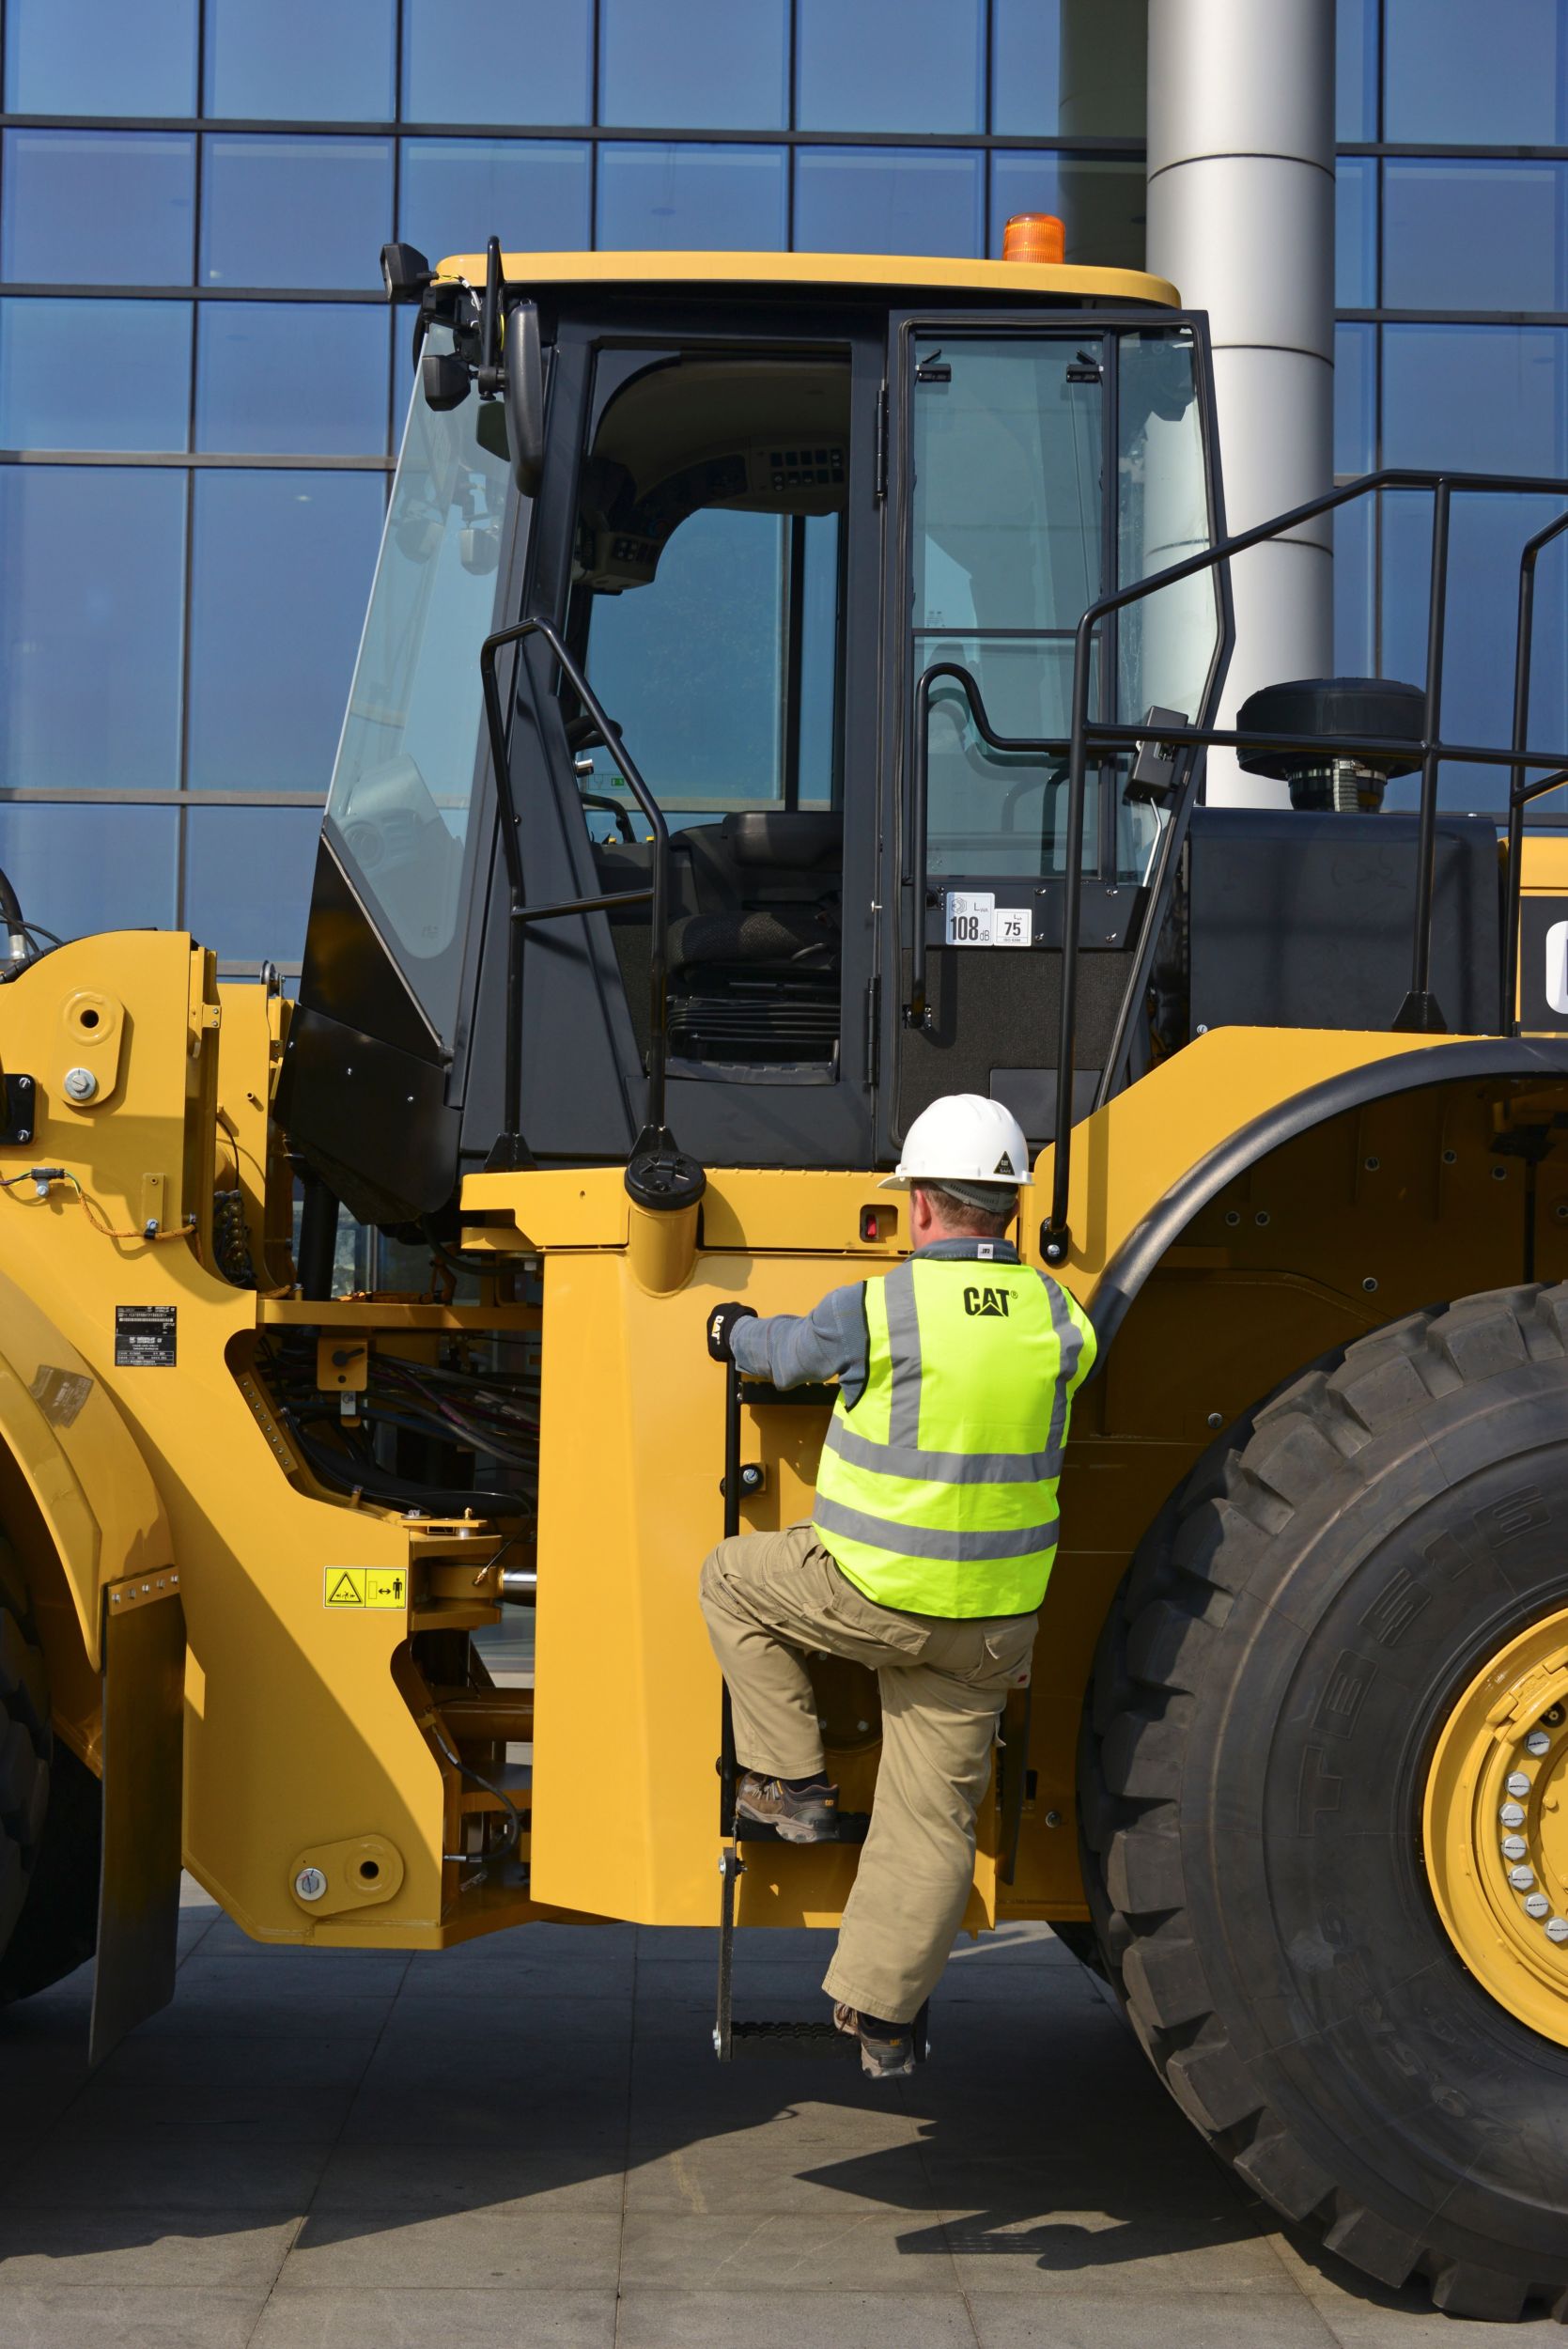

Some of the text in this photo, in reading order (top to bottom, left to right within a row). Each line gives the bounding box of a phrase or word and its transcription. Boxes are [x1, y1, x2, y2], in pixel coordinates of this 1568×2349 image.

[950, 916, 989, 941] 108 dB
[1004, 922, 1021, 936] 75
[963, 1286, 1010, 1317] CAT
